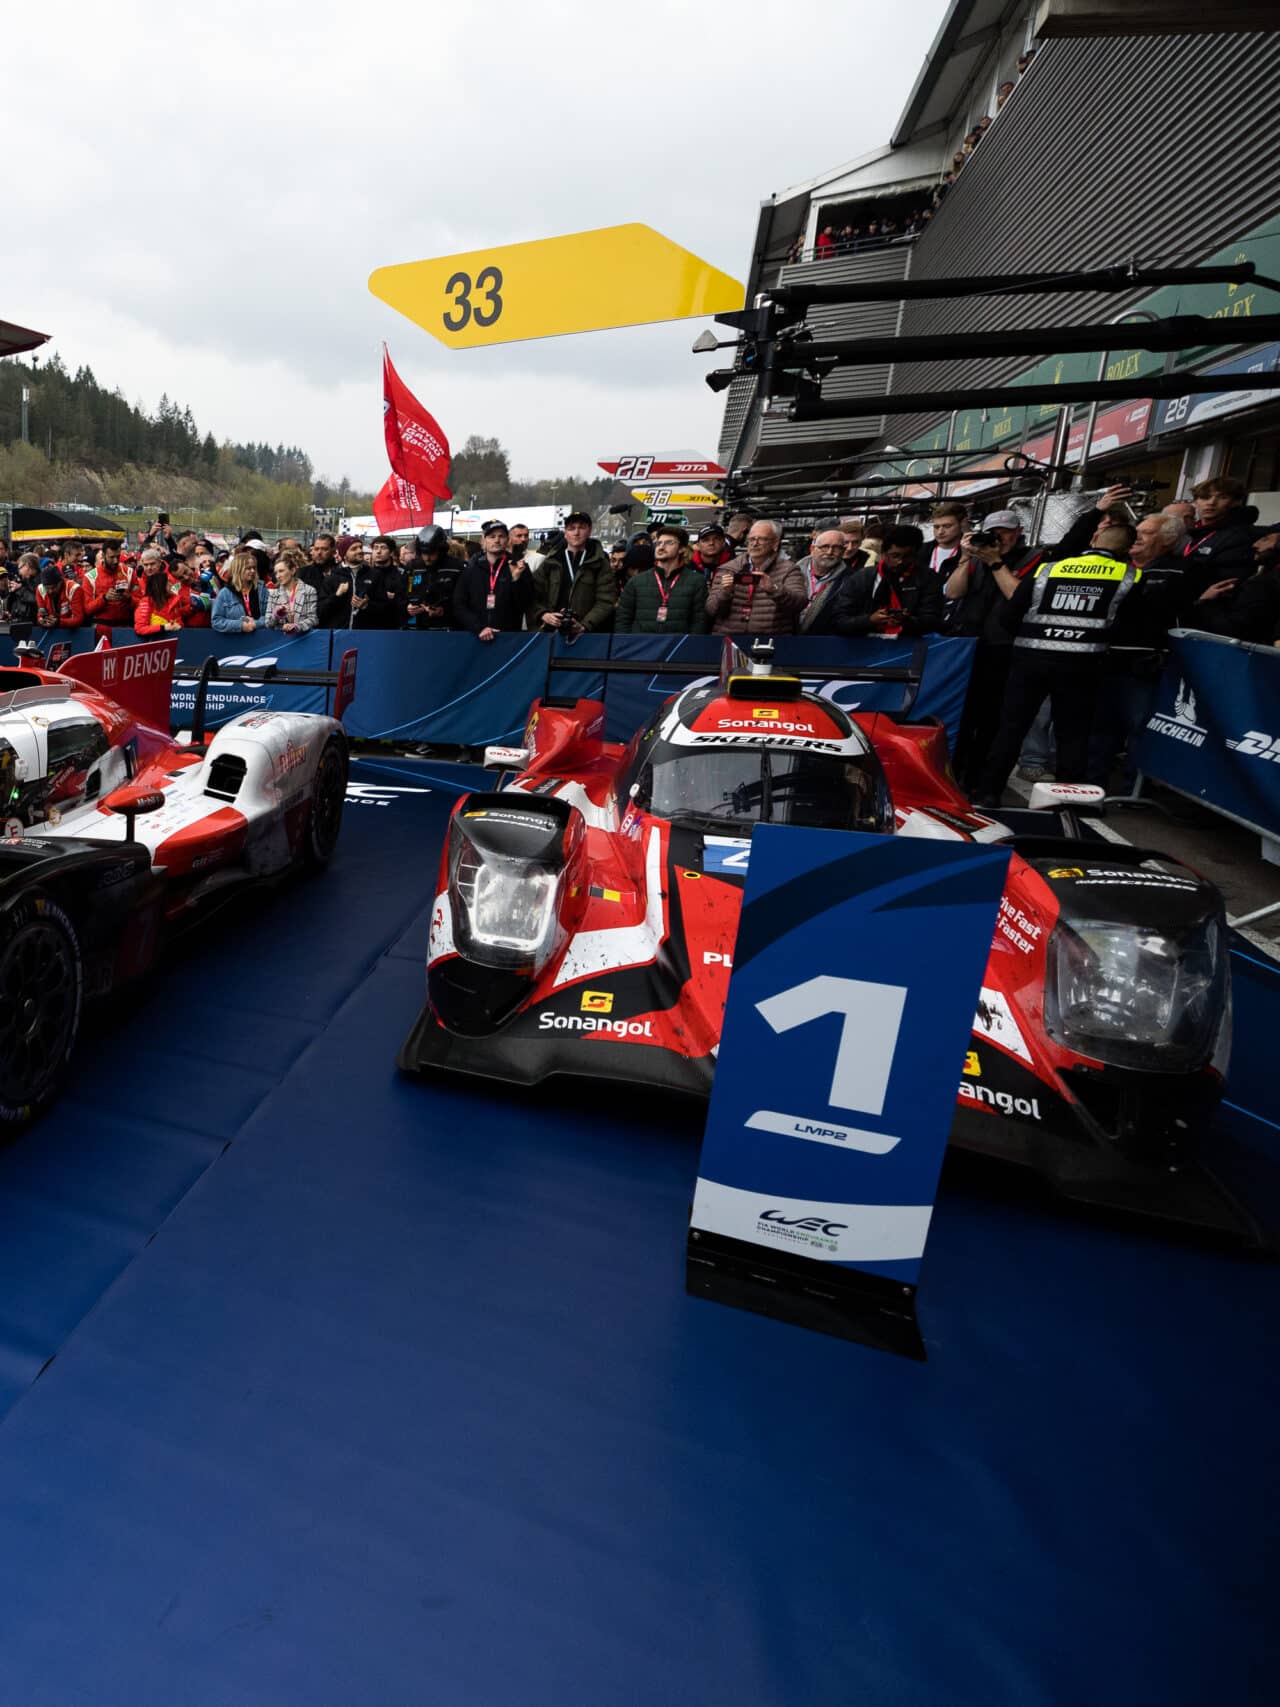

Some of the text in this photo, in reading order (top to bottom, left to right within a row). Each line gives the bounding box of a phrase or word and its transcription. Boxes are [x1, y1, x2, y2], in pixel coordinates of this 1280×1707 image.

[442, 266, 503, 331] 33
[1106, 352, 1141, 381] ROLEX
[1164, 395, 1190, 424] 28
[401, 433, 436, 462] Racing
[405, 427, 441, 457] GAZOO
[411, 421, 445, 455] TOYOTA
[615, 456, 708, 480] 28 JOTA
[643, 489, 672, 506] 38
[1060, 564, 1116, 576] SECURITY
[1056, 585, 1104, 594] PROTECTION
[1044, 628, 1085, 639] 1797
[103, 648, 170, 681] HY DENSO
[170, 693, 266, 704] WORL ENDURANCE
[718, 718, 815, 733] Sonangol
[1146, 717, 1206, 747] MICHELIN
[691, 735, 844, 752] SKECHERS
[1051, 788, 1101, 796] ORLEN
[998, 917, 1035, 954] Faster
[1013, 910, 1042, 940] Fast
[538, 1012, 653, 1038] Sonangol
[754, 975, 907, 1116] 1
[958, 1081, 1042, 1120] angol
[794, 1123, 848, 1141] LMP2
[759, 1209, 849, 1237] WEC
